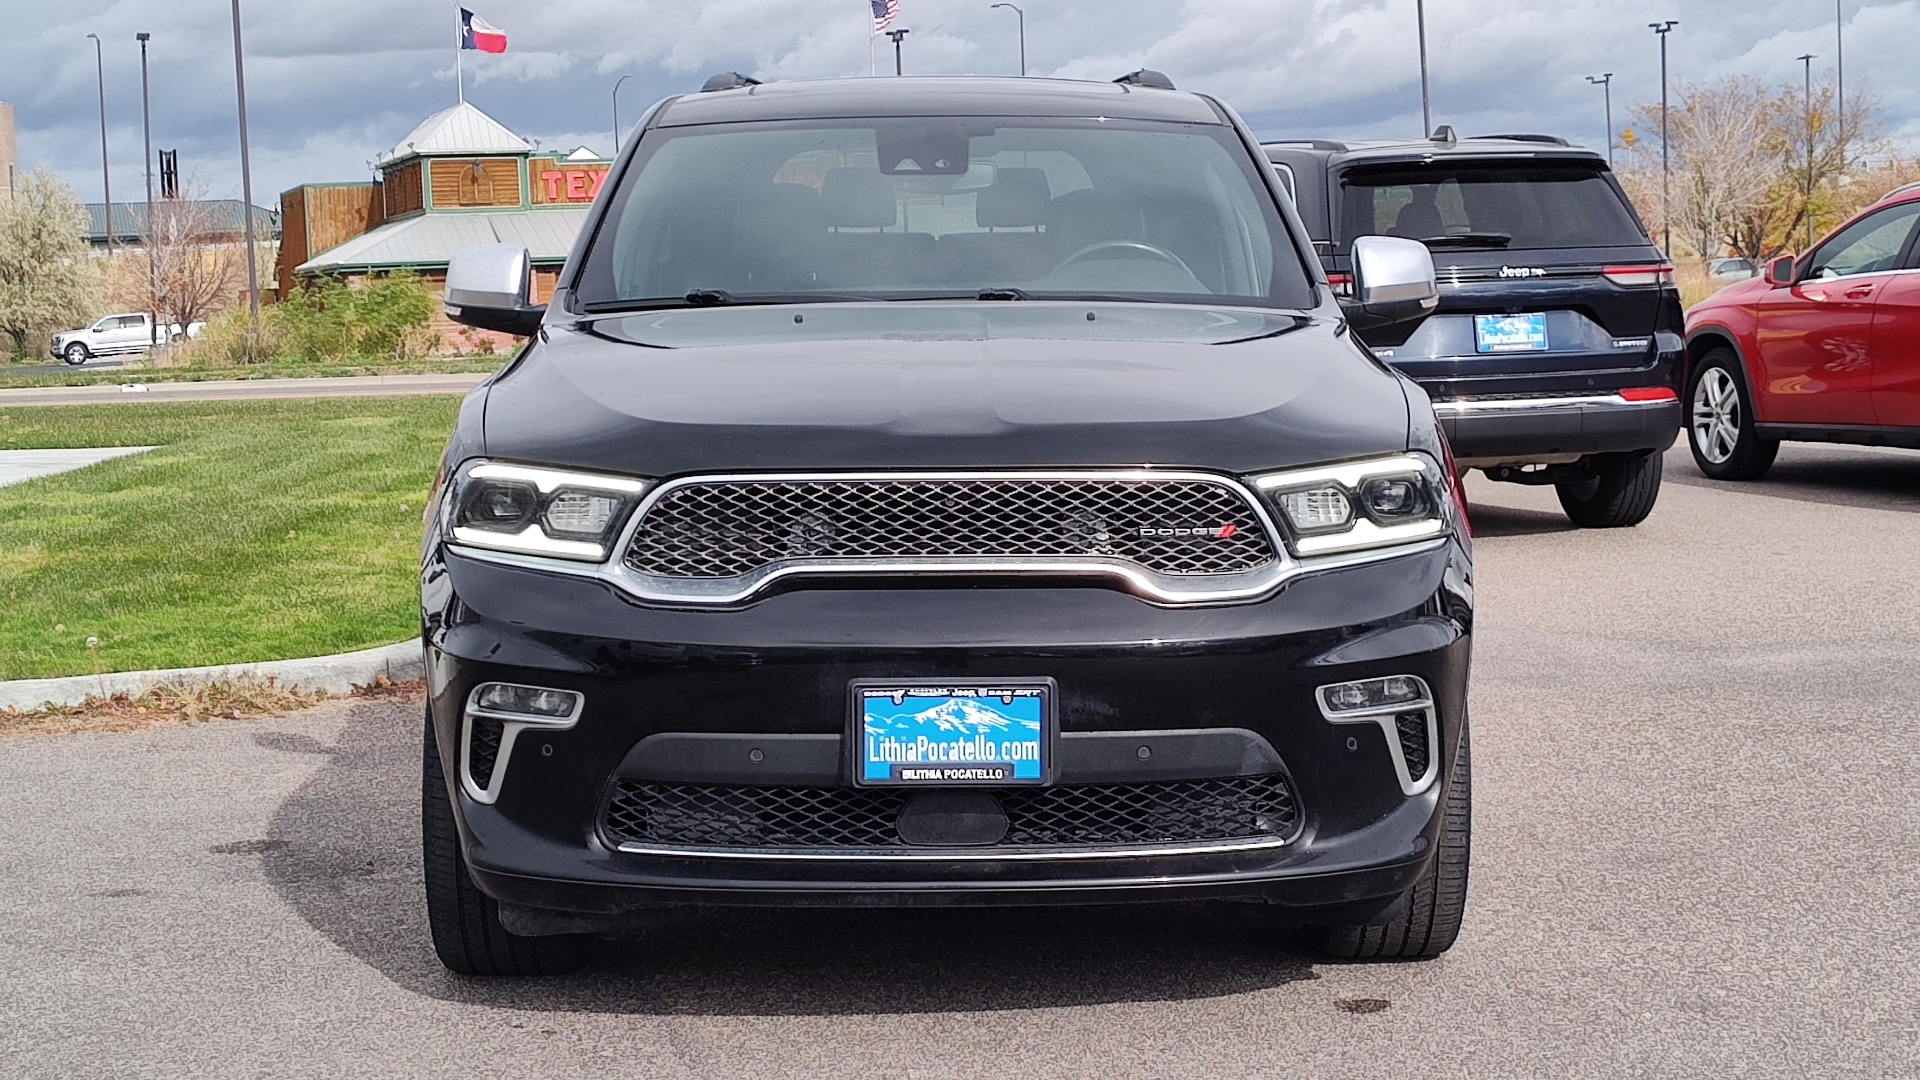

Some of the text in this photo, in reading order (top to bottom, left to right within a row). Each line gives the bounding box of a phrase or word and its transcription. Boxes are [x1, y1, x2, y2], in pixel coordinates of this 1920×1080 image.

[541, 170, 608, 200] TEX
[1499, 266, 1530, 278] Jeep
[1140, 527, 1223, 537] DODGE
[869, 735, 1039, 762] LithiaPocatello.com
[911, 769, 1003, 780] LITHIA POCATELLO
